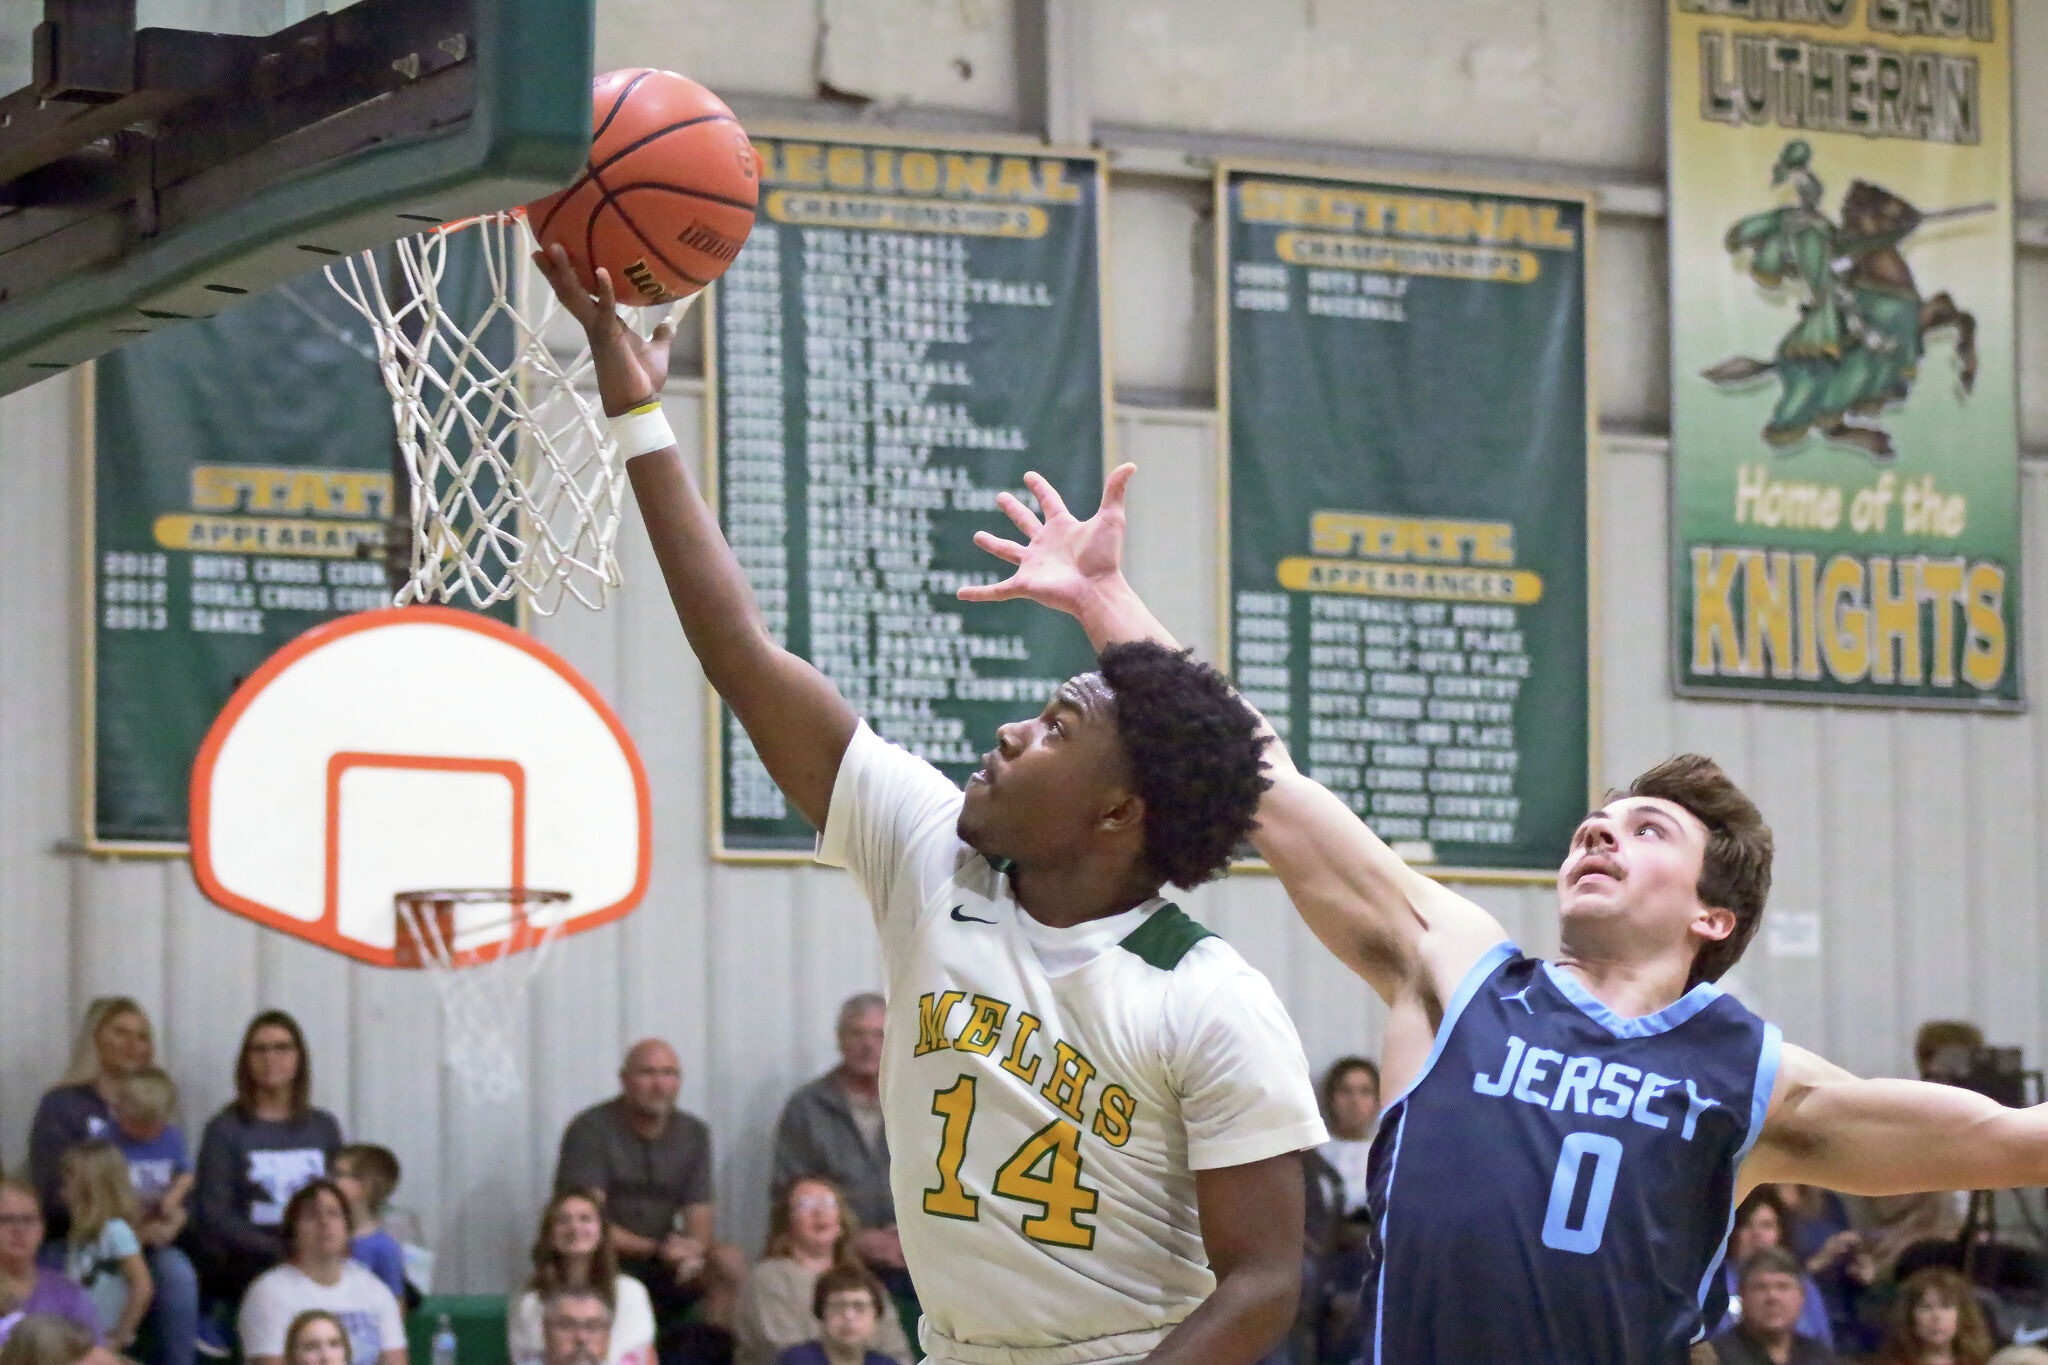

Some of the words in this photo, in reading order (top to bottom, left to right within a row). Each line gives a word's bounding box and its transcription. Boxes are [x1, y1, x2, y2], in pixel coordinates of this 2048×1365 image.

[1699, 28, 1982, 145] LUTHERAN
[1239, 180, 1574, 251] SECTIONAL
[191, 462, 393, 517] STAT
[1309, 509, 1515, 566] STATE
[1735, 463, 1842, 531] Home
[1851, 472, 1896, 533] of
[1902, 475, 1966, 538] the
[1309, 565, 1515, 597] APPEARANCES
[1690, 545, 2007, 690] KNIGHTS
[914, 990, 1137, 1147] MELHS
[1473, 1035, 1722, 1142] JERSEY
[922, 1073, 1100, 1251] 14
[1541, 1131, 1623, 1255] 0
